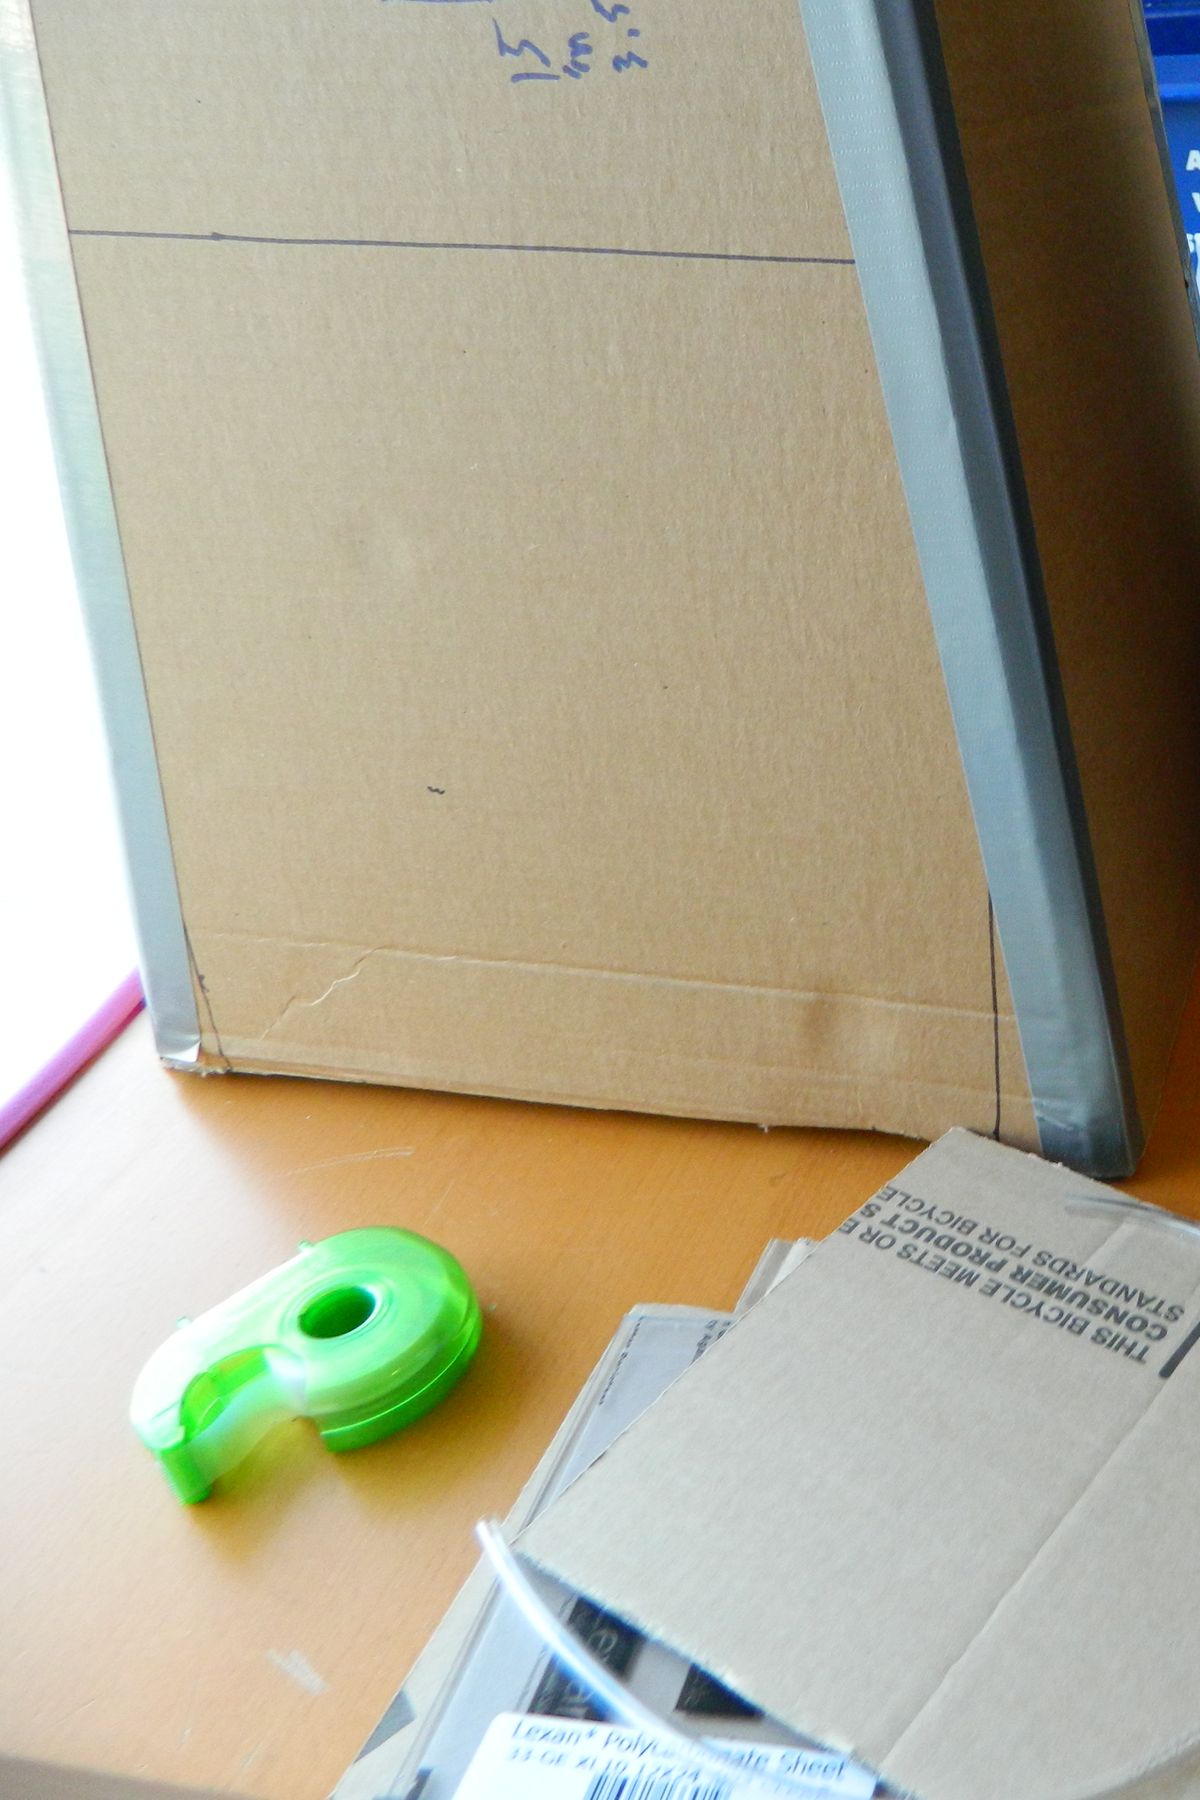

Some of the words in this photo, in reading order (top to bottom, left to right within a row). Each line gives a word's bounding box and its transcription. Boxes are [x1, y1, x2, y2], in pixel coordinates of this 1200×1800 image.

[858, 1224, 898, 1252] OR
[880, 1214, 1009, 1273] PRODUCT
[979, 1225, 1032, 1260] FOR
[896, 1240, 981, 1289] MEETS
[1031, 1248, 1186, 1323] STANDARDS
[980, 1279, 1091, 1337] BICYCLE
[1008, 1263, 1169, 1342] CONSUMER
[1091, 1326, 1150, 1366] THIS
[779, 1749, 847, 1780] Sheet
